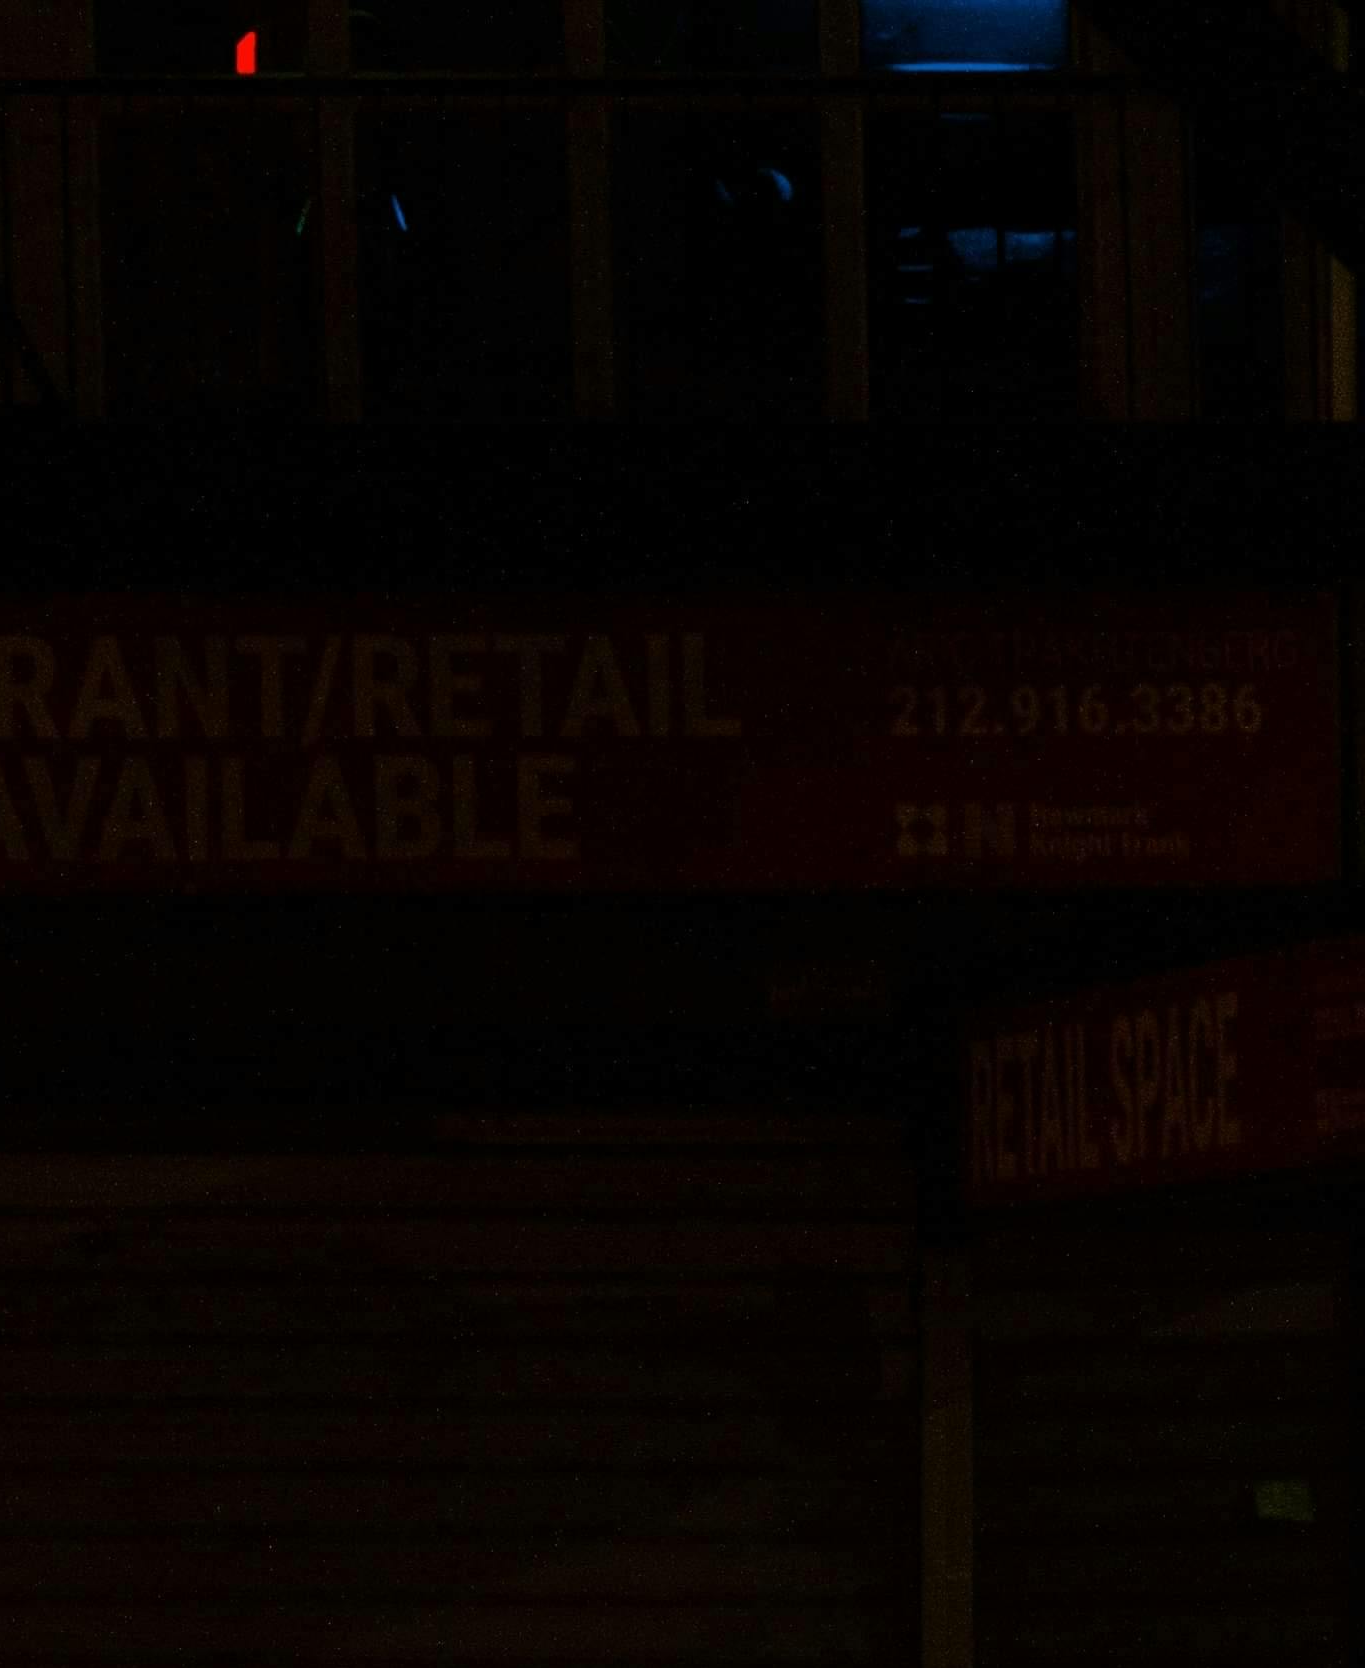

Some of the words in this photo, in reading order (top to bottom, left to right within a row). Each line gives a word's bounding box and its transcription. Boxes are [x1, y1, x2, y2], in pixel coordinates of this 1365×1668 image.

[889, 682, 1263, 737] 212.916.3386
[969, 1024, 1100, 1182] RETAIL
[1110, 991, 1243, 1166] SPACE
